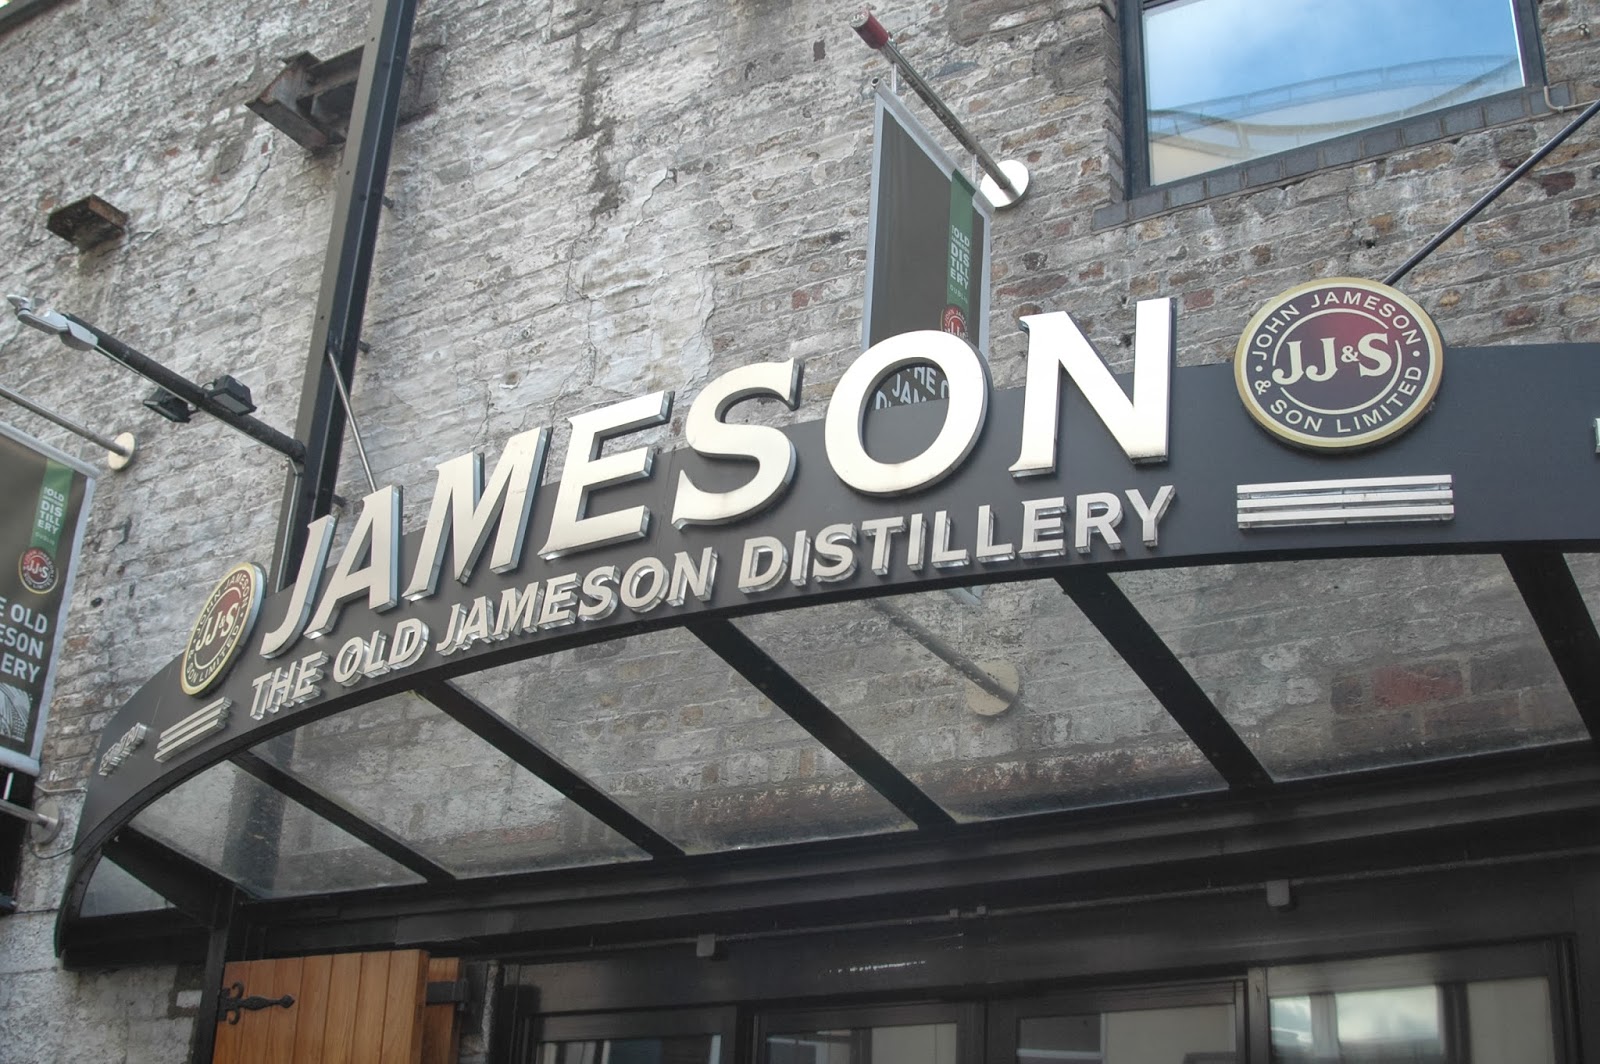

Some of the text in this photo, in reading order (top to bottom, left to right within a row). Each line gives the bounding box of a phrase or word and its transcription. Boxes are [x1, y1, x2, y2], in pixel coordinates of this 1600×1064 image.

[953, 226, 970, 248] OLD
[950, 242, 970, 268] DIS
[950, 255, 969, 280] TILL
[950, 267, 969, 290] ERY
[1252, 291, 1421, 361] JOHN JAMESON
[1271, 332, 1393, 386] JJ&S
[1254, 366, 1422, 433] & SON LIMITED
[260, 297, 1175, 660] JAMESON
[40, 500, 63, 518] DIS
[46, 488, 65, 502] OLD
[37, 519, 60, 535] ERY
[39, 510, 61, 527] TILL
[250, 484, 1177, 720] THE OLD JAMESON DISTILLERY
[11, 603, 48, 634] OLD
[195, 602, 240, 651] JJ&S
[1, 652, 41, 684] ERY
[186, 662, 200, 683] SON
[199, 625, 240, 683] LIMITED
